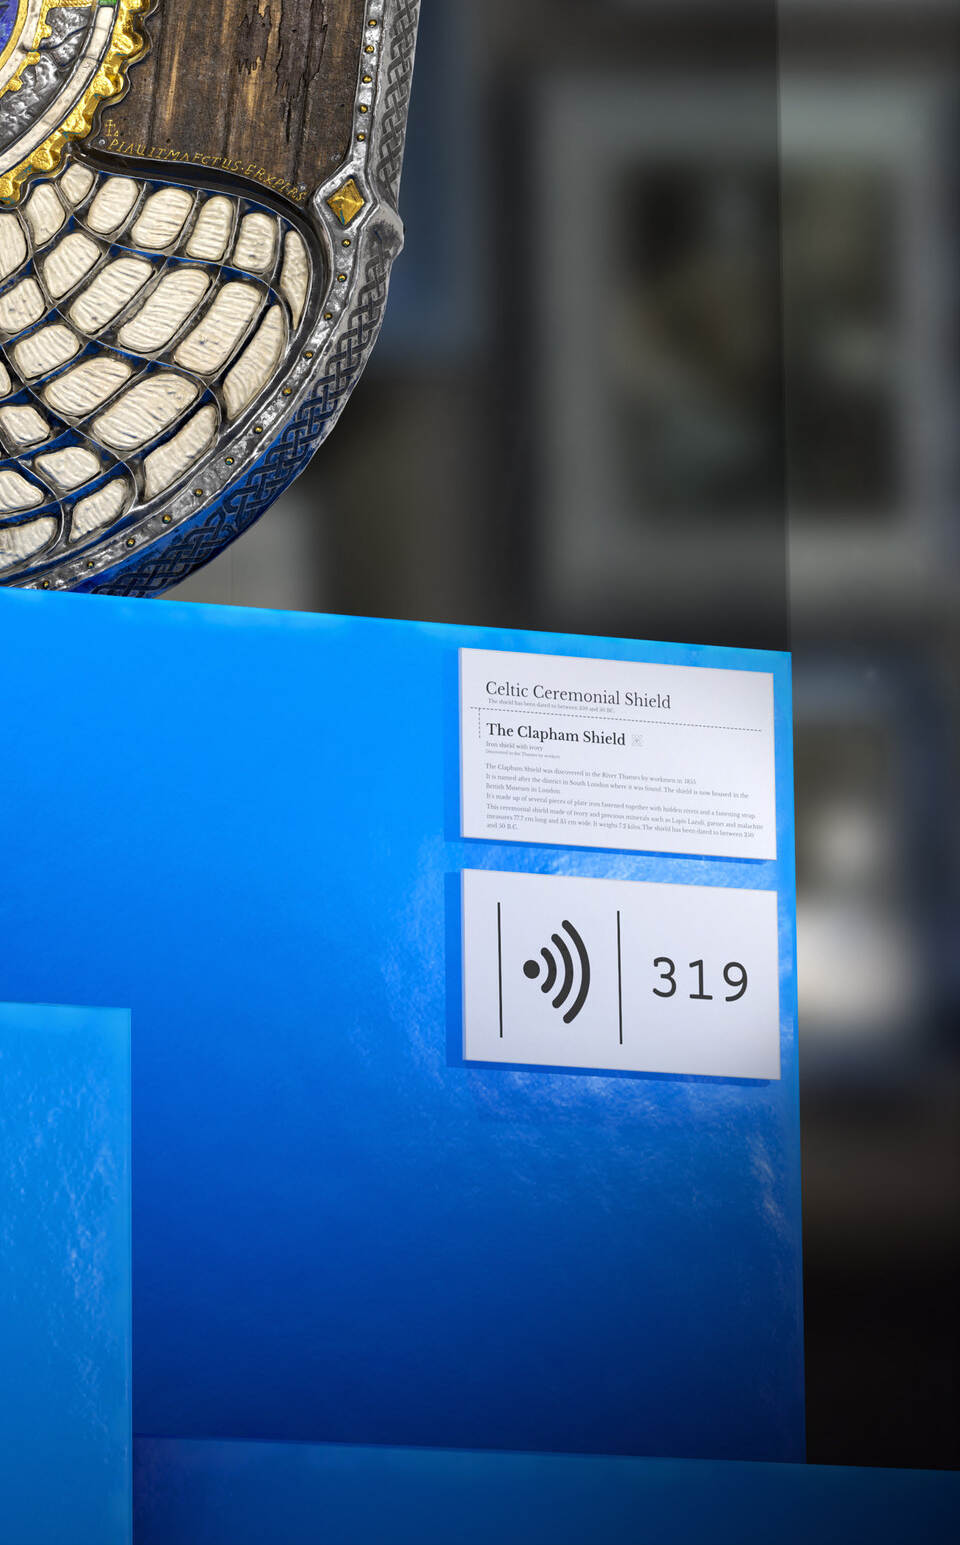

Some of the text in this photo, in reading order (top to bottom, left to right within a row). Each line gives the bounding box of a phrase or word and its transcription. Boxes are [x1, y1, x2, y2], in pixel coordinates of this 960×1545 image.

[486, 681, 671, 709] Celtic Ceremonial Shield
[487, 722, 625, 746] The Clapham Shield
[529, 744, 544, 752] ivory
[498, 764, 523, 773] Clapham
[554, 768, 584, 776] discovered
[618, 773, 640, 781] Thames
[506, 784, 530, 792] Museum
[549, 798, 566, 806] pieces
[625, 803, 648, 812] together
[715, 810, 741, 818] fastening
[573, 810, 589, 818] ivory
[601, 812, 625, 821] precious
[672, 817, 687, 825] Lapis
[707, 820, 724, 828] garnet
[652, 956, 748, 1002] 319
